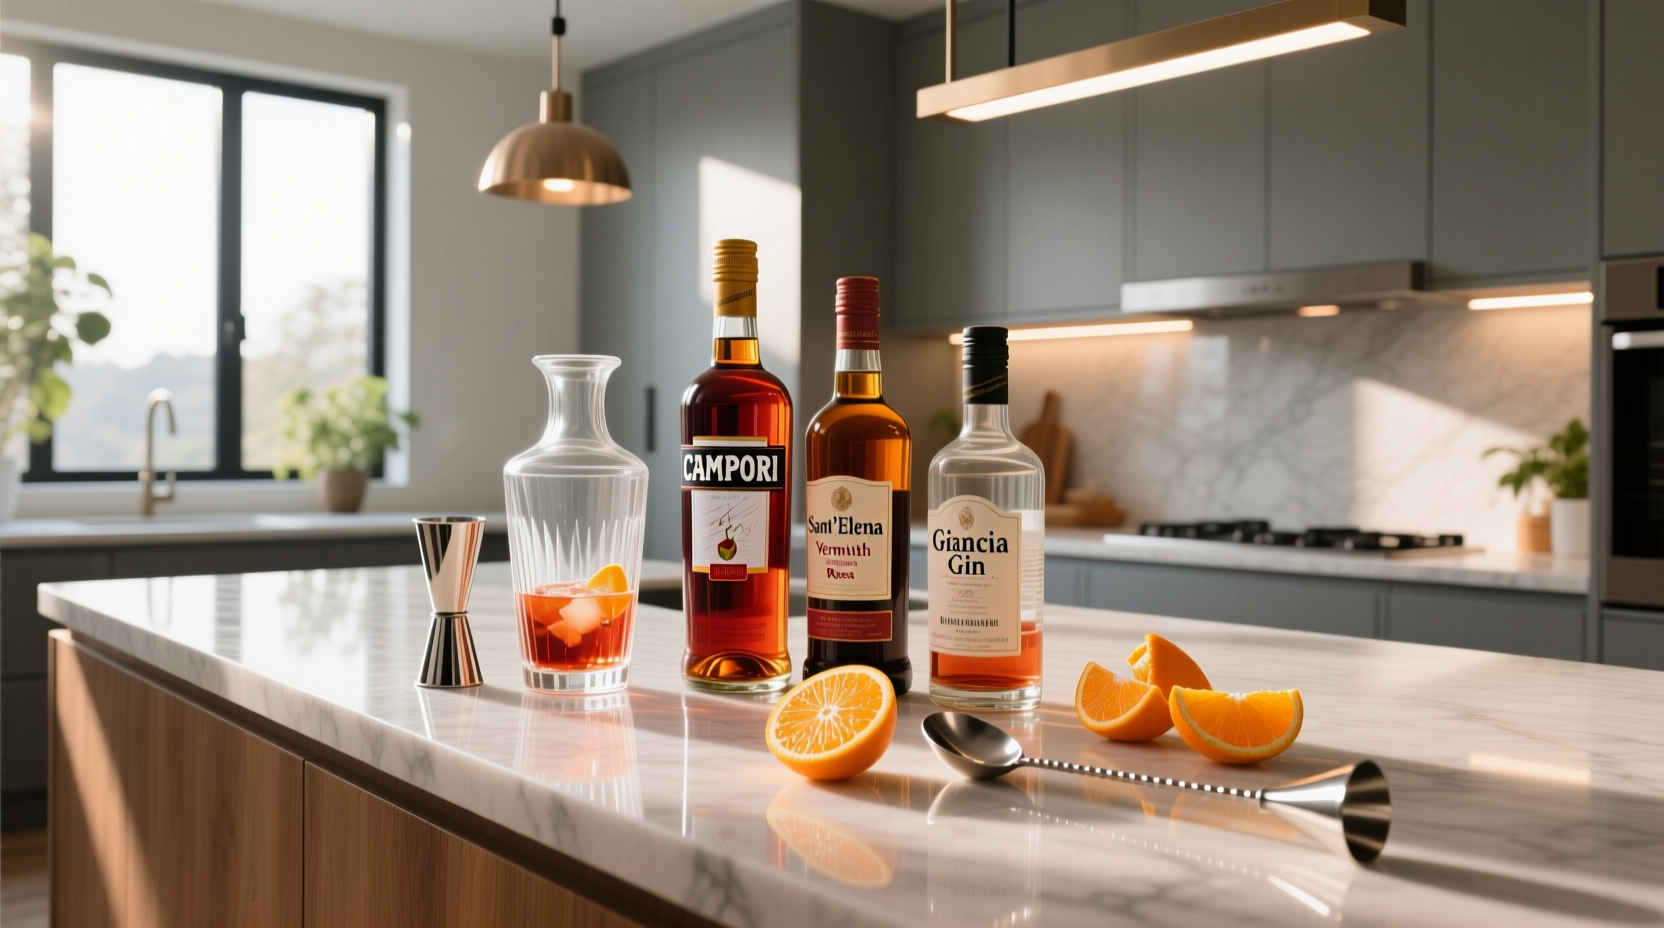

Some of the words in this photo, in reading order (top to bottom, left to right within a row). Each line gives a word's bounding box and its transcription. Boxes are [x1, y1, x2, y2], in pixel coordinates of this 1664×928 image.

[683, 454, 778, 482] CAMPORI
[808, 515, 883, 535] Sant'Elena
[932, 528, 1009, 553] Giancia
[948, 554, 986, 575] Gin
